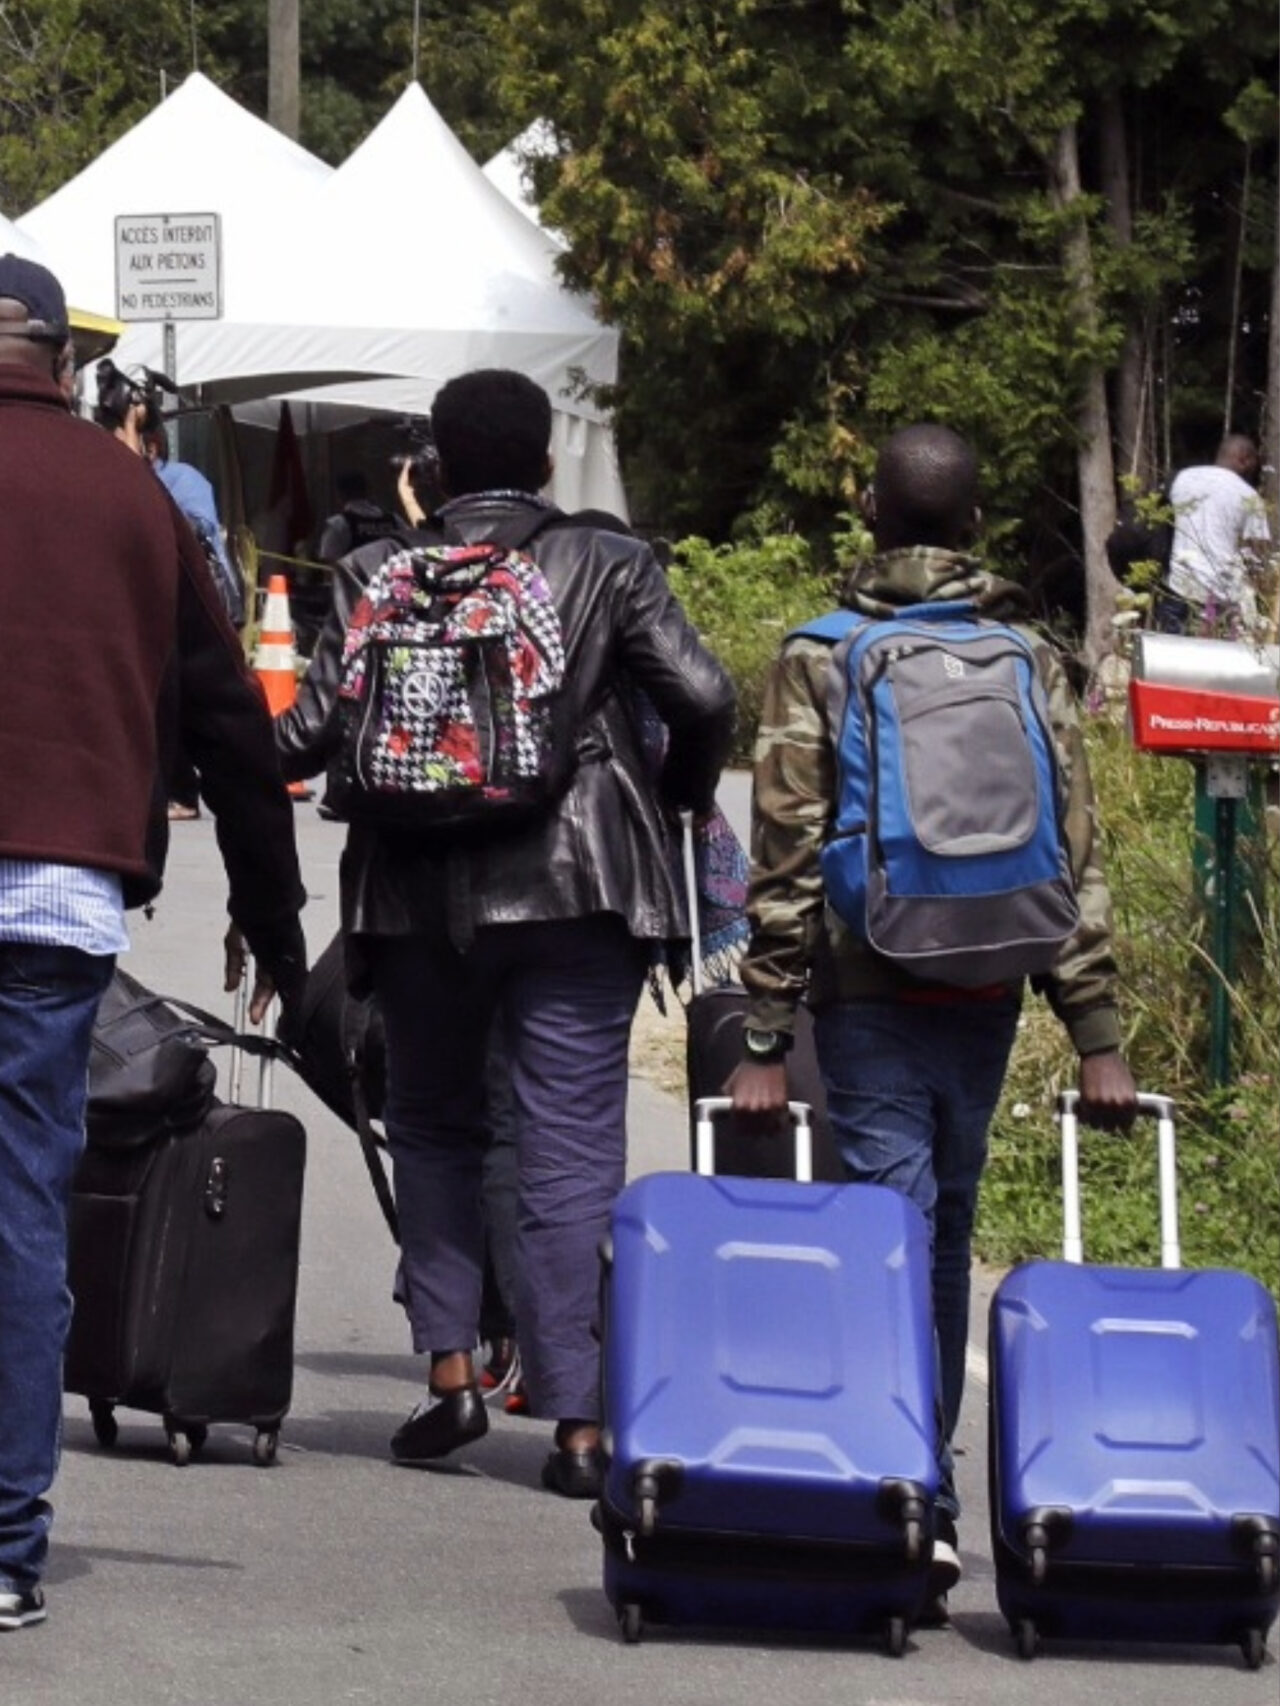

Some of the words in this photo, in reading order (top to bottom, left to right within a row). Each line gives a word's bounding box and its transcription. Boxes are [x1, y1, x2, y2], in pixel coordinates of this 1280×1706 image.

[163, 225, 212, 243] INTERDIT
[130, 254, 153, 271] AUX
[122, 293, 138, 309] NO
[142, 291, 214, 308] PEDESTRIANS
